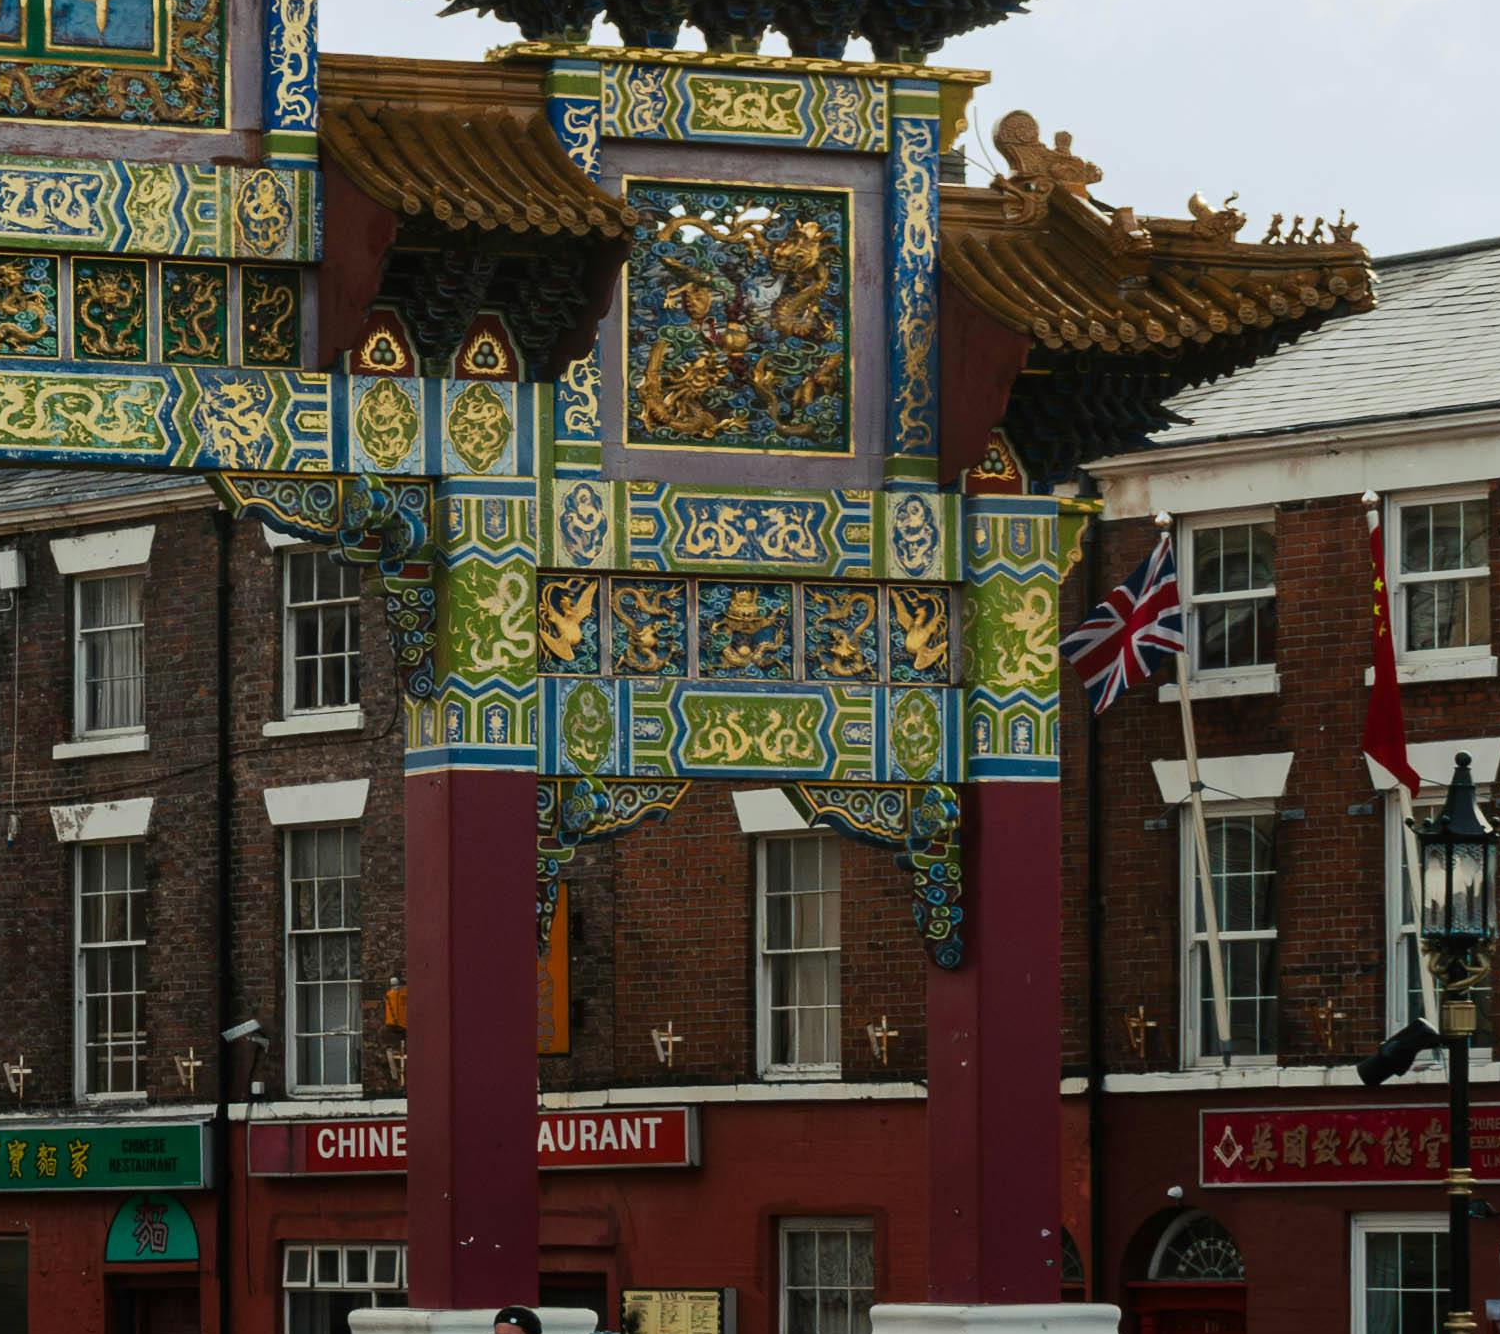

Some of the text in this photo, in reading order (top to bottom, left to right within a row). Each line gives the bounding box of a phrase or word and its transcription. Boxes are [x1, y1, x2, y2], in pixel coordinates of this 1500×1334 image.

[121, 1138, 166, 1154] CHINESE
[316, 1117, 662, 1159] CHINE AURANT
[108, 1157, 179, 1174] RESTAURANT
